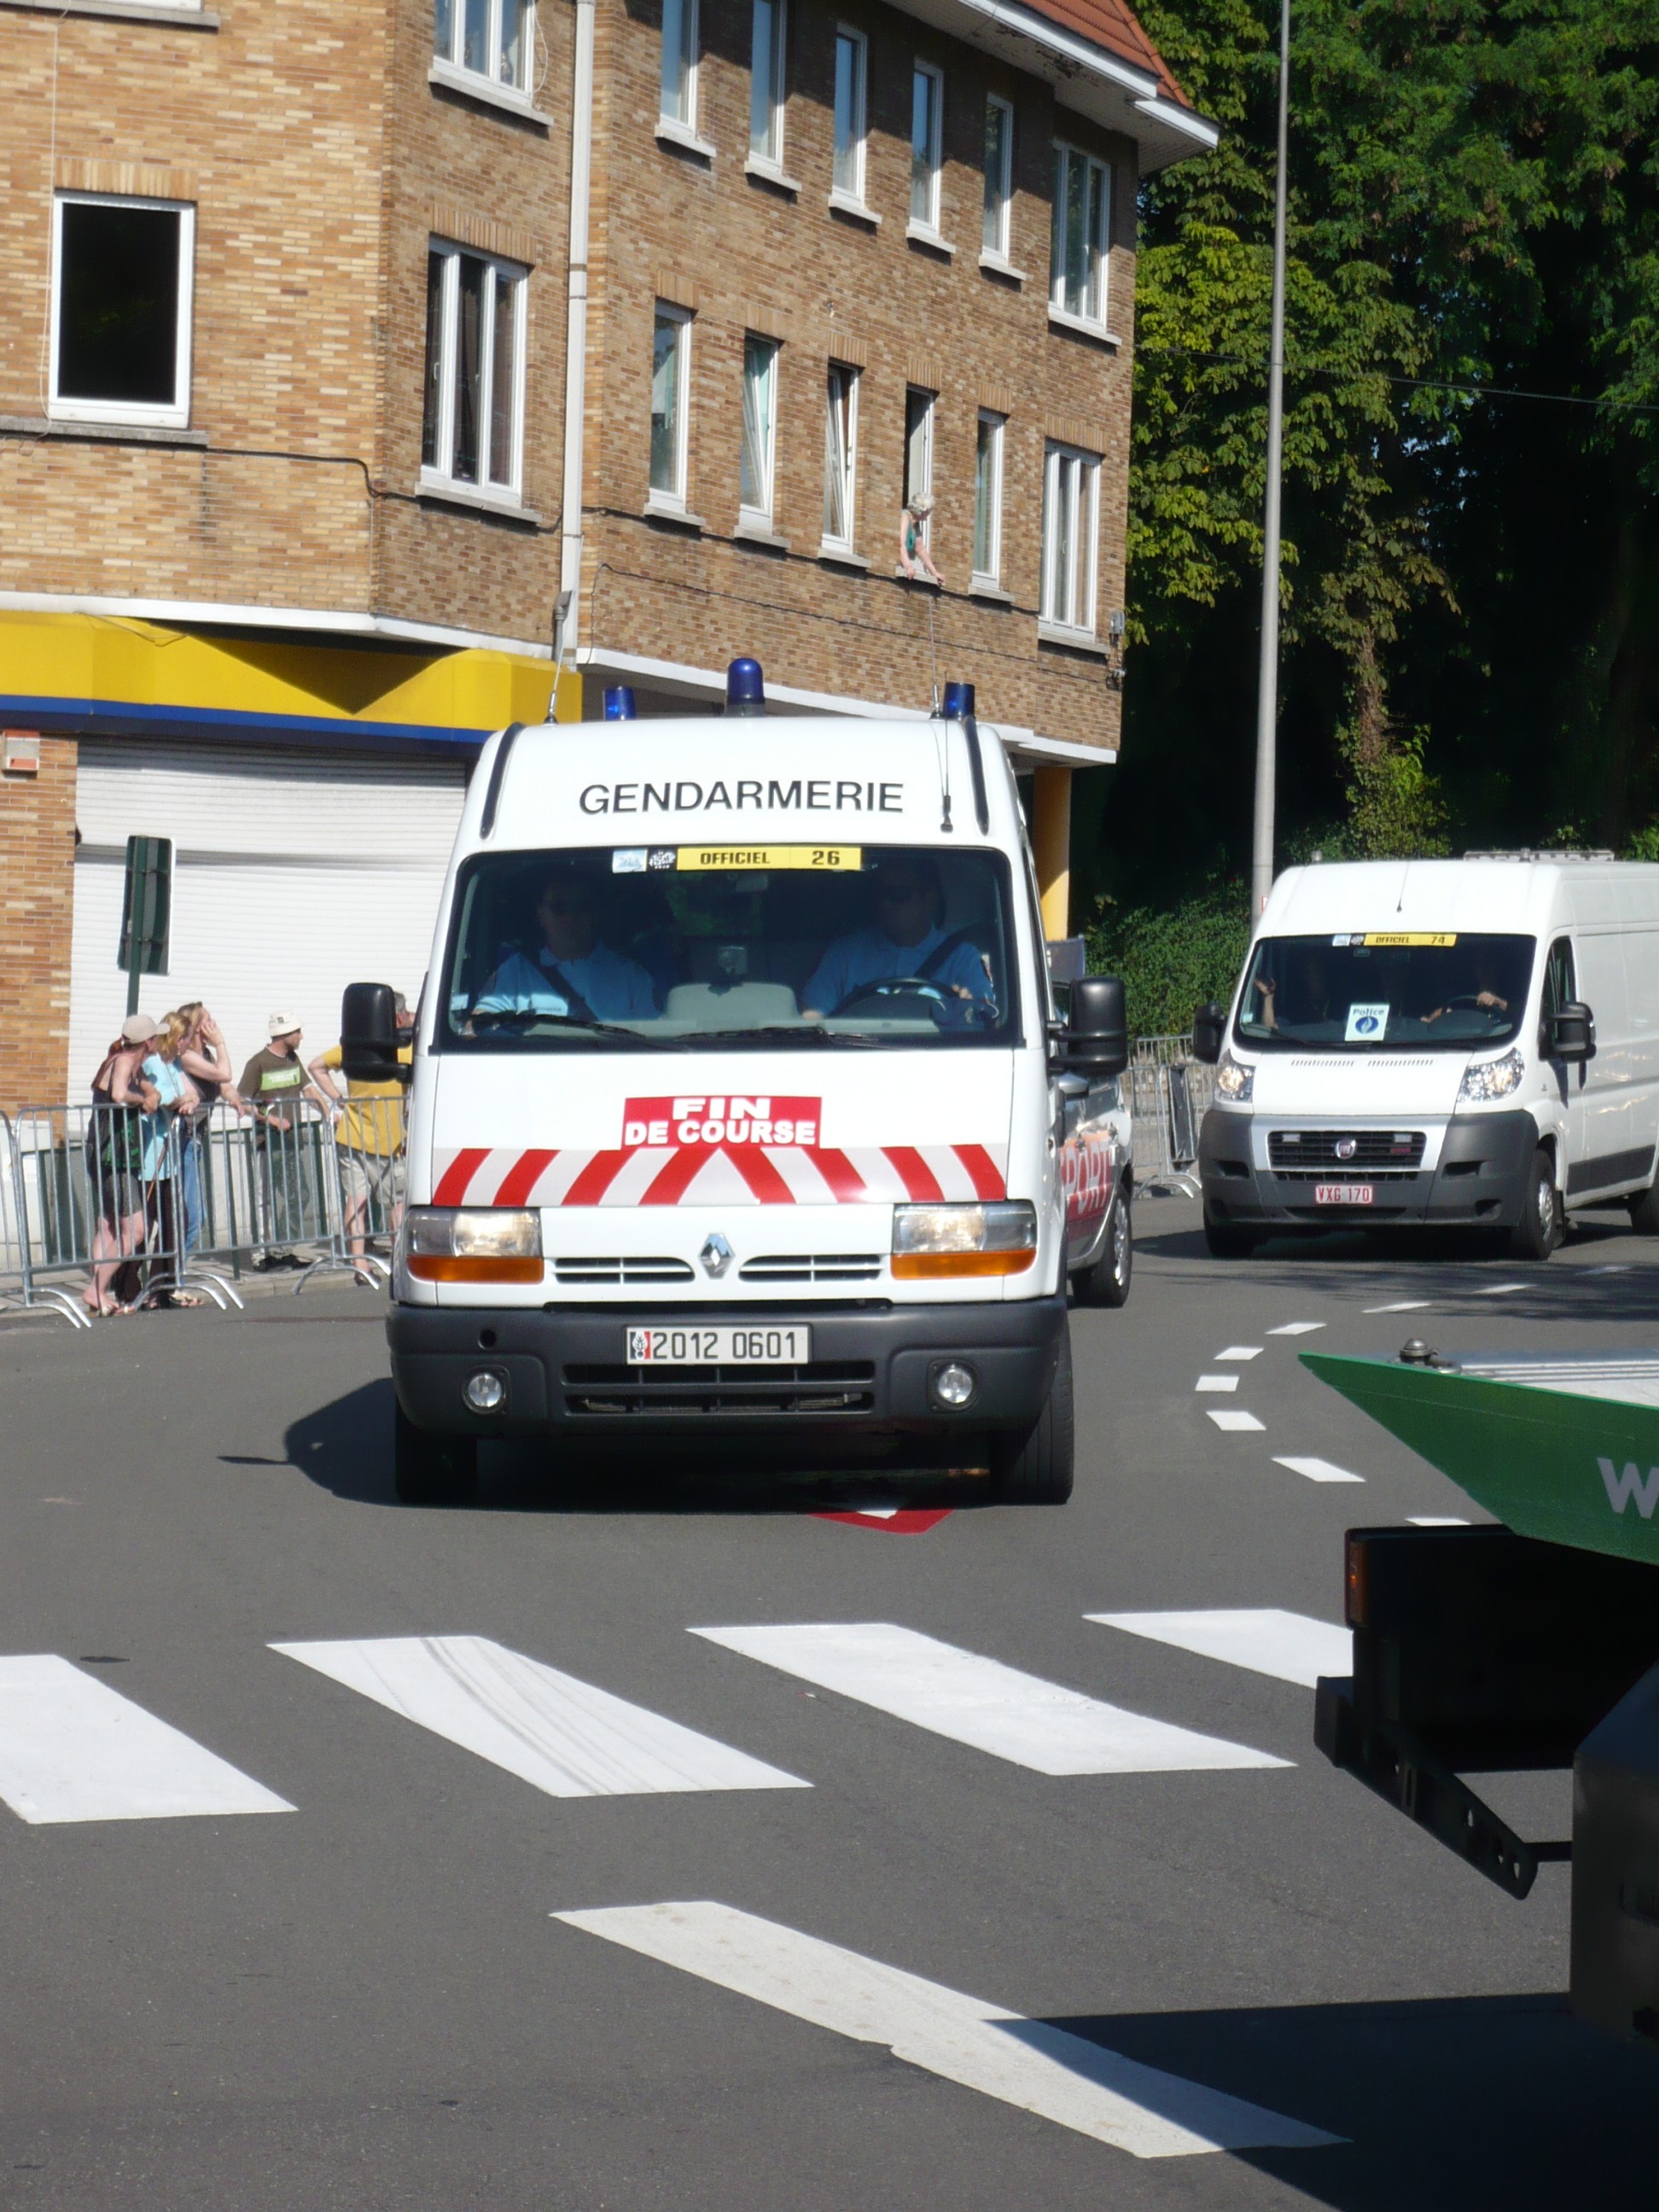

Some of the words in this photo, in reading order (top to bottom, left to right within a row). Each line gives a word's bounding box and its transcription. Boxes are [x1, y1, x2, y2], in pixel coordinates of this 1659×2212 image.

[579, 779, 904, 815] GENDARMERIE
[700, 851, 770, 865] OFFICIEL
[812, 850, 840, 866] 26
[1376, 935, 1410, 944] OFFICIEL
[1430, 935, 1445, 944] 74
[1353, 1008, 1384, 1016] Police
[672, 1097, 770, 1120] FIN
[625, 1121, 669, 1145] DE
[678, 1120, 816, 1145] COURSE
[1319, 1188, 1341, 1202] VXG
[1348, 1188, 1370, 1202] 170
[652, 1332, 719, 1359] 2012
[732, 1331, 795, 1359] 0601
